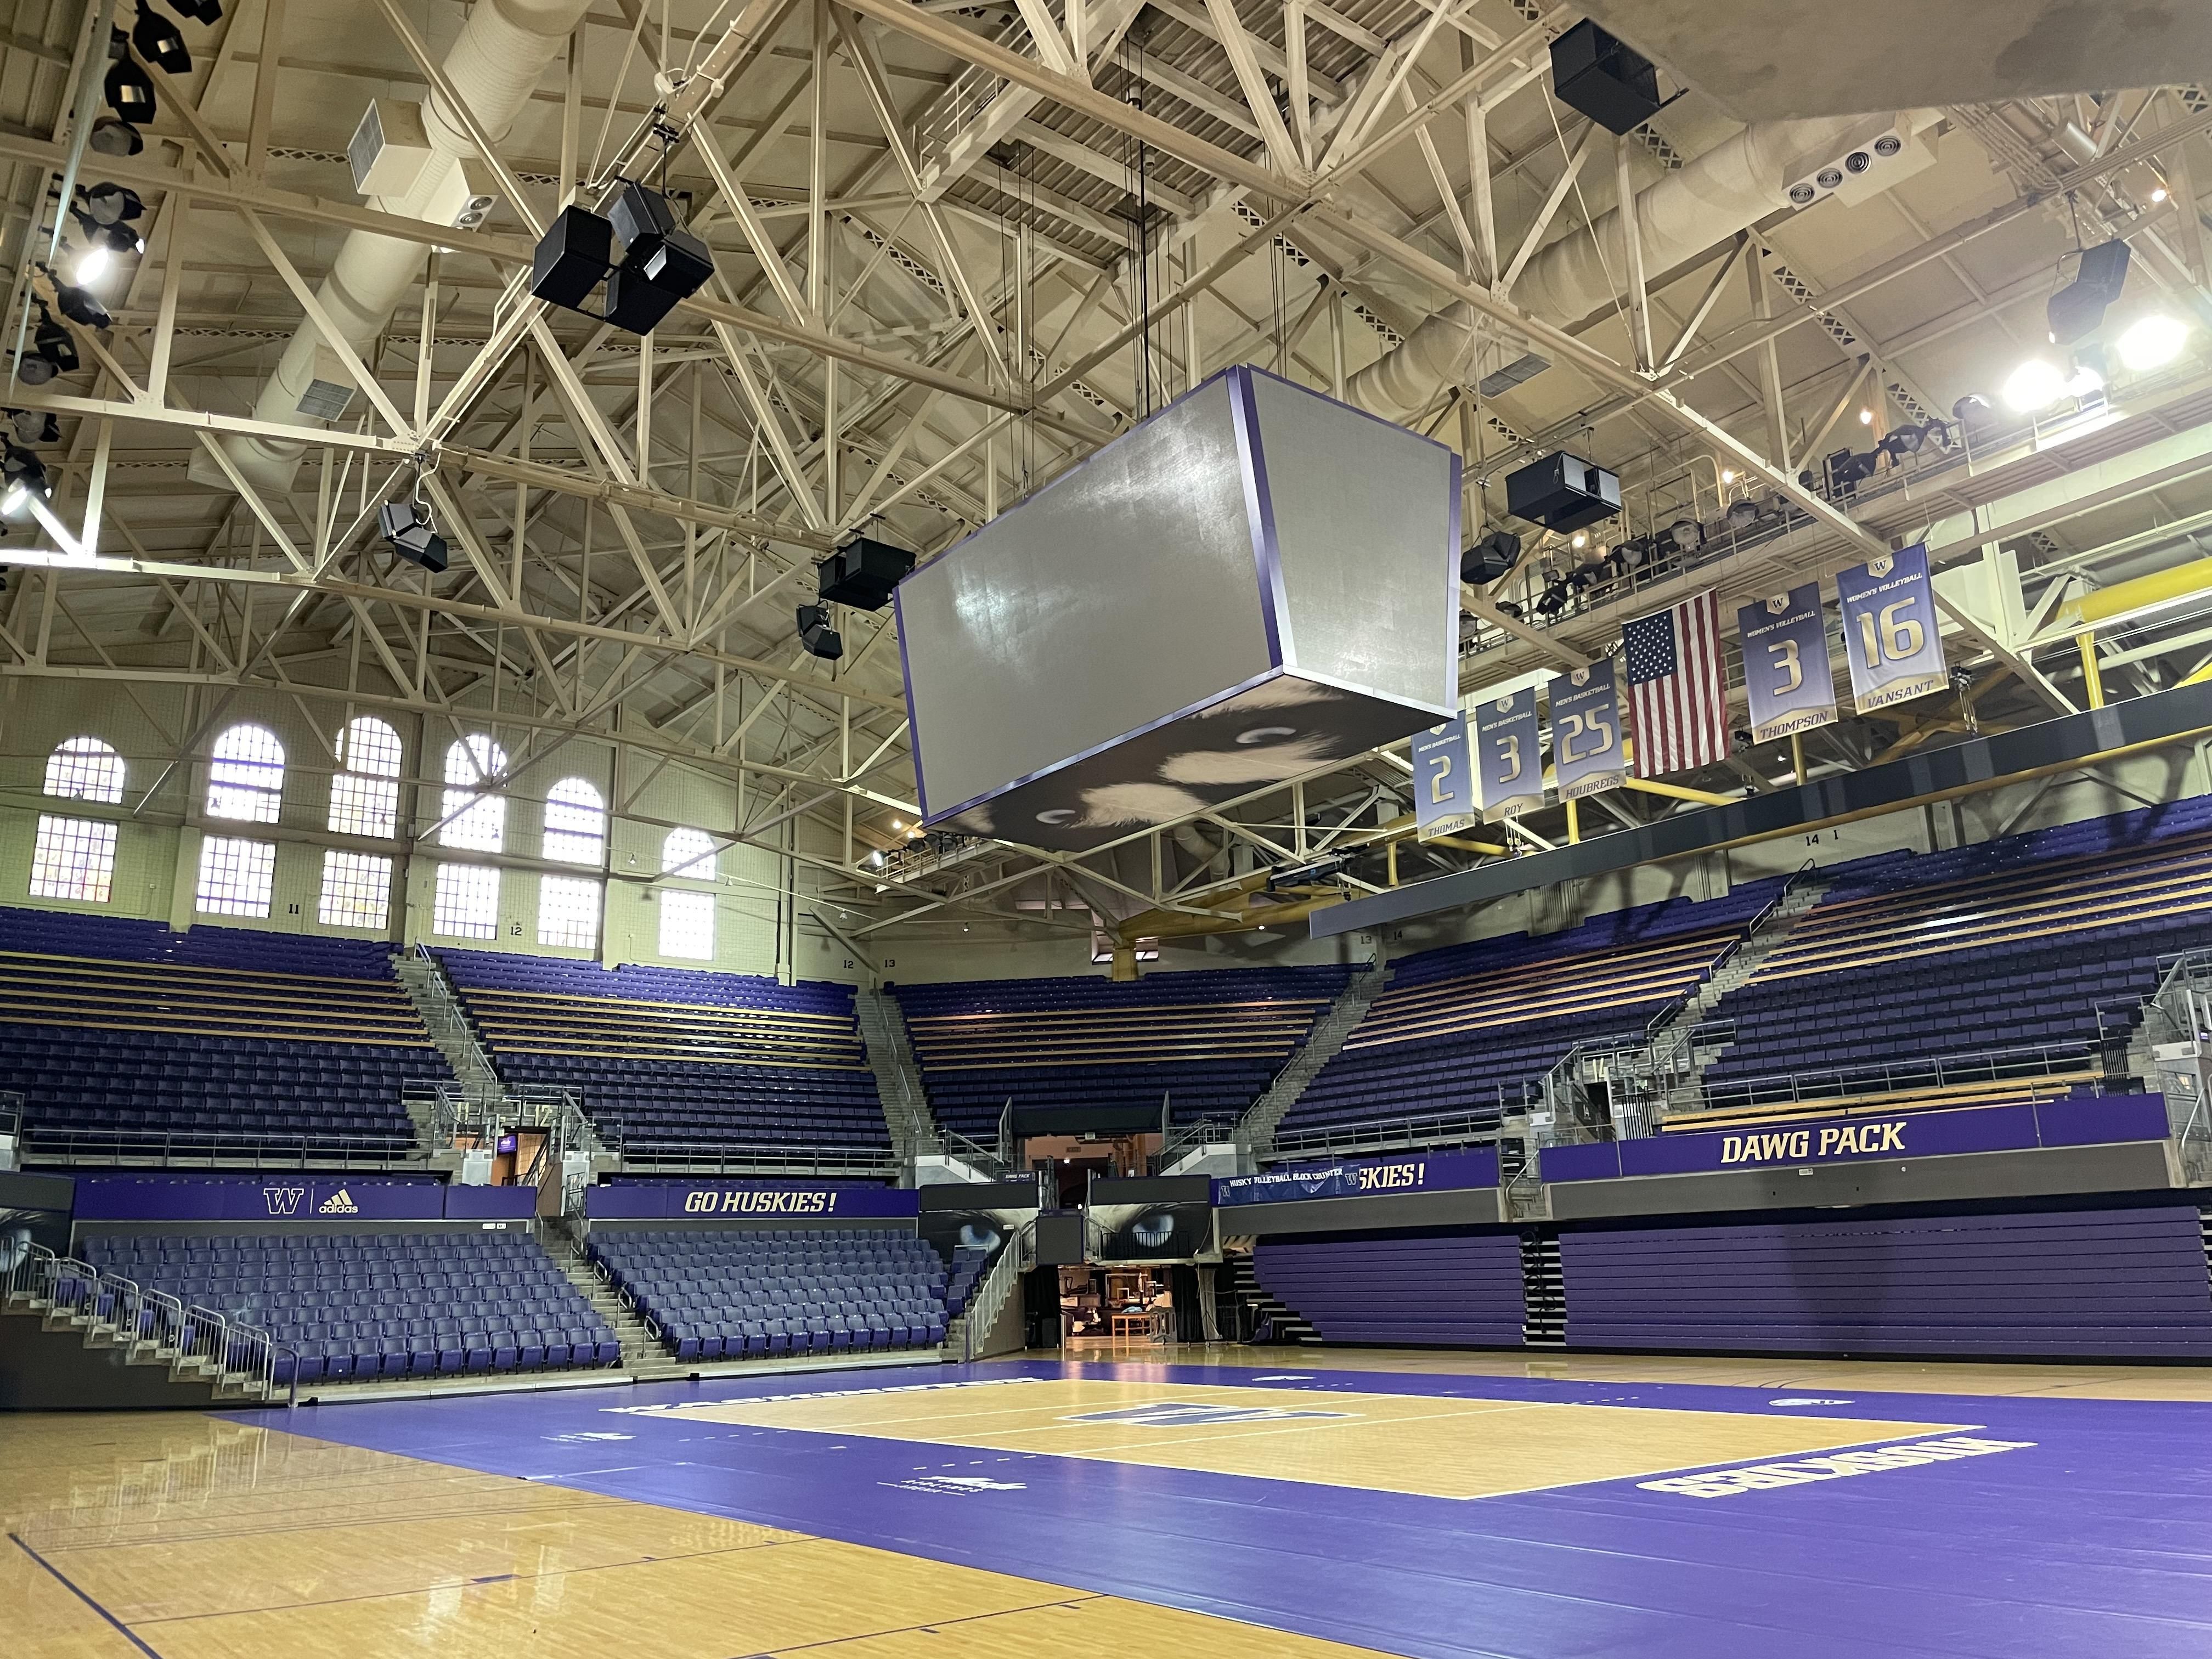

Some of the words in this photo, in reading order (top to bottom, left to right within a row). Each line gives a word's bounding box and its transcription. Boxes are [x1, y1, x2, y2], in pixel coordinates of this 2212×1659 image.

[1874, 560, 1887, 571] W
[1847, 588, 1877, 603] WOMEN'S
[1878, 572, 1923, 593] VOLLEYBALL
[1772, 598, 1784, 608] W
[1747, 624, 1775, 637] WOMEN'S
[1776, 611, 1816, 629] VOLLEYBALL
[1856, 596, 1925, 669] 16
[1576, 671, 1584, 680] W
[1768, 639, 1802, 696] 3
[1501, 699, 1509, 707] W
[1555, 696, 1572, 707] MEN'S
[1573, 683, 1611, 701] BASKETBALL
[1867, 680, 1934, 708] VANSANT
[1482, 721, 1498, 732] MEN'S
[1498, 711, 1532, 727] BASKETBALL
[1760, 711, 1829, 740] THOMPSON
[1432, 733, 1461, 748] BASKETBALL
[1559, 703, 1613, 764] 25
[1497, 735, 1521, 783] 3
[1429, 755, 1454, 804] 2
[1565, 775, 1619, 799] HOUBREGS
[1504, 803, 1523, 817] ROY
[1428, 819, 1465, 837] THOMAS
[1806, 834, 1819, 846] 14
[289, 904, 299, 915] 11
[510, 926, 522, 936] 12
[1361, 935, 1372, 944] 13
[1394, 930, 1403, 940] 14
[843, 960, 854, 969] 12
[884, 960, 895, 968] 13
[1720, 1131, 1810, 1163] DAWG
[1818, 1122, 1907, 1156] PACK
[1229, 1177, 1251, 1187] HUSKY
[1312, 1168, 1342, 1180] COUNTER
[1345, 1172, 1358, 1186] W
[263, 1188, 304, 1214] W
[319, 1204, 358, 1214] adidas
[685, 1192, 719, 1212] GO
[598, 1376, 1046, 1413] WASHINGTON
[1635, 1436, 2039, 1498] HUSKIES
